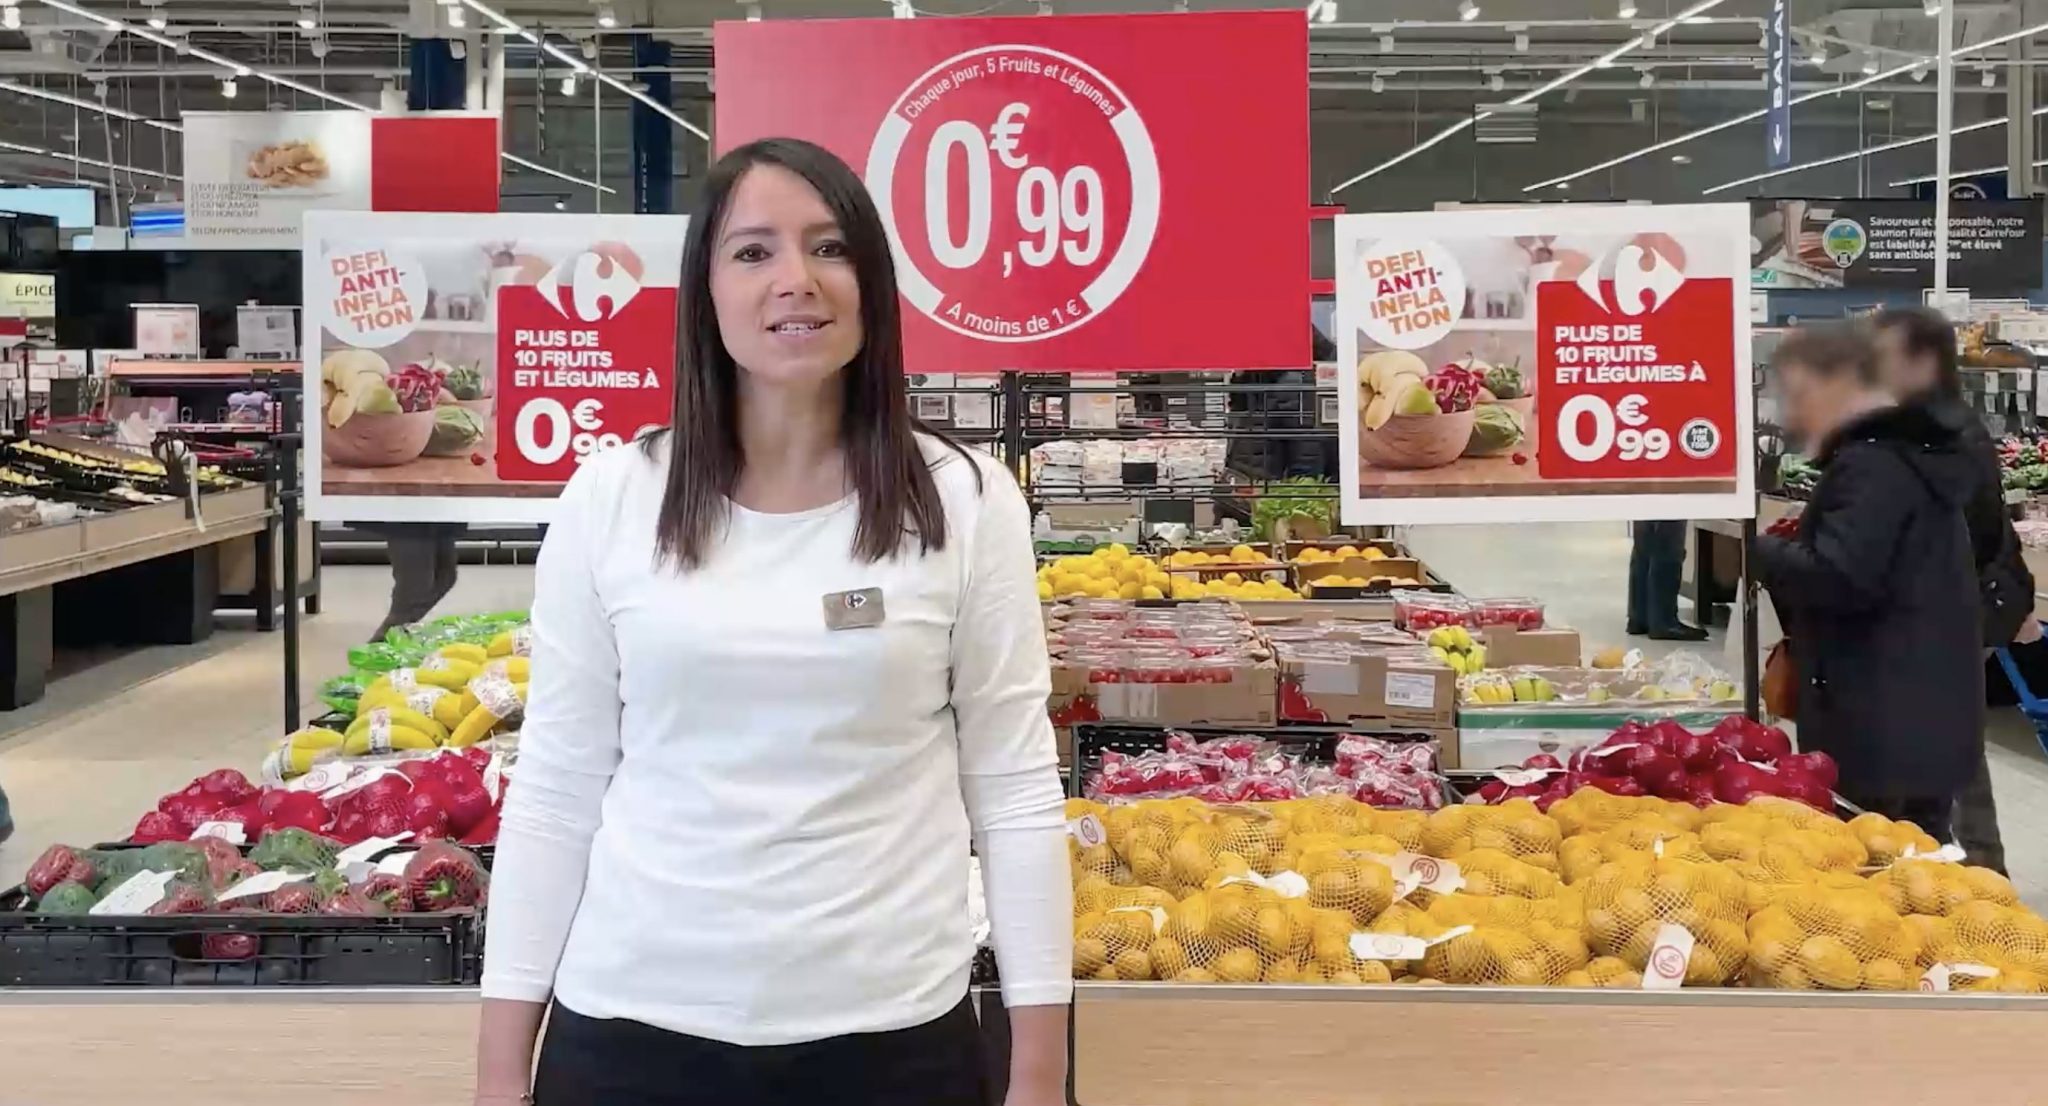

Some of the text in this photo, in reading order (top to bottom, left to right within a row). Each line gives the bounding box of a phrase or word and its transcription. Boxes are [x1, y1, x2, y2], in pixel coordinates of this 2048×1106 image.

[904, 56, 1116, 119] Chaque jour, 5 Fruits et Légumes
[1869, 229, 1908, 238] saumon
[1979, 228, 2026, 238] Carrefour
[1870, 216, 1920, 226] Savoureux
[1921, 216, 1933, 226] et
[1997, 217, 2024, 226] notre
[1869, 241, 1885, 249] est
[1961, 241, 1973, 249] et
[1974, 239, 2003, 250] élevé
[1869, 251, 1893, 260] sans
[331, 248, 387, 276] DEFI
[1367, 249, 1425, 279] DEFI
[341, 267, 406, 296] ANTI-
[1377, 267, 1442, 297] ANTI-
[333, 287, 408, 317] INFLA
[1370, 287, 1446, 319] INFLA
[351, 305, 413, 333] TION
[945, 298, 1082, 335] A moins de 1 €
[1388, 305, 1452, 335] TION
[514, 330, 599, 347] PLUS DE
[1555, 324, 1643, 342] PLUS DE
[514, 350, 613, 367] 10 FRUITS
[1555, 345, 1658, 363] 10 FRUITS
[514, 365, 660, 388] ET LÉGUMES À
[1556, 361, 1707, 384] ET LÉGUMES À
